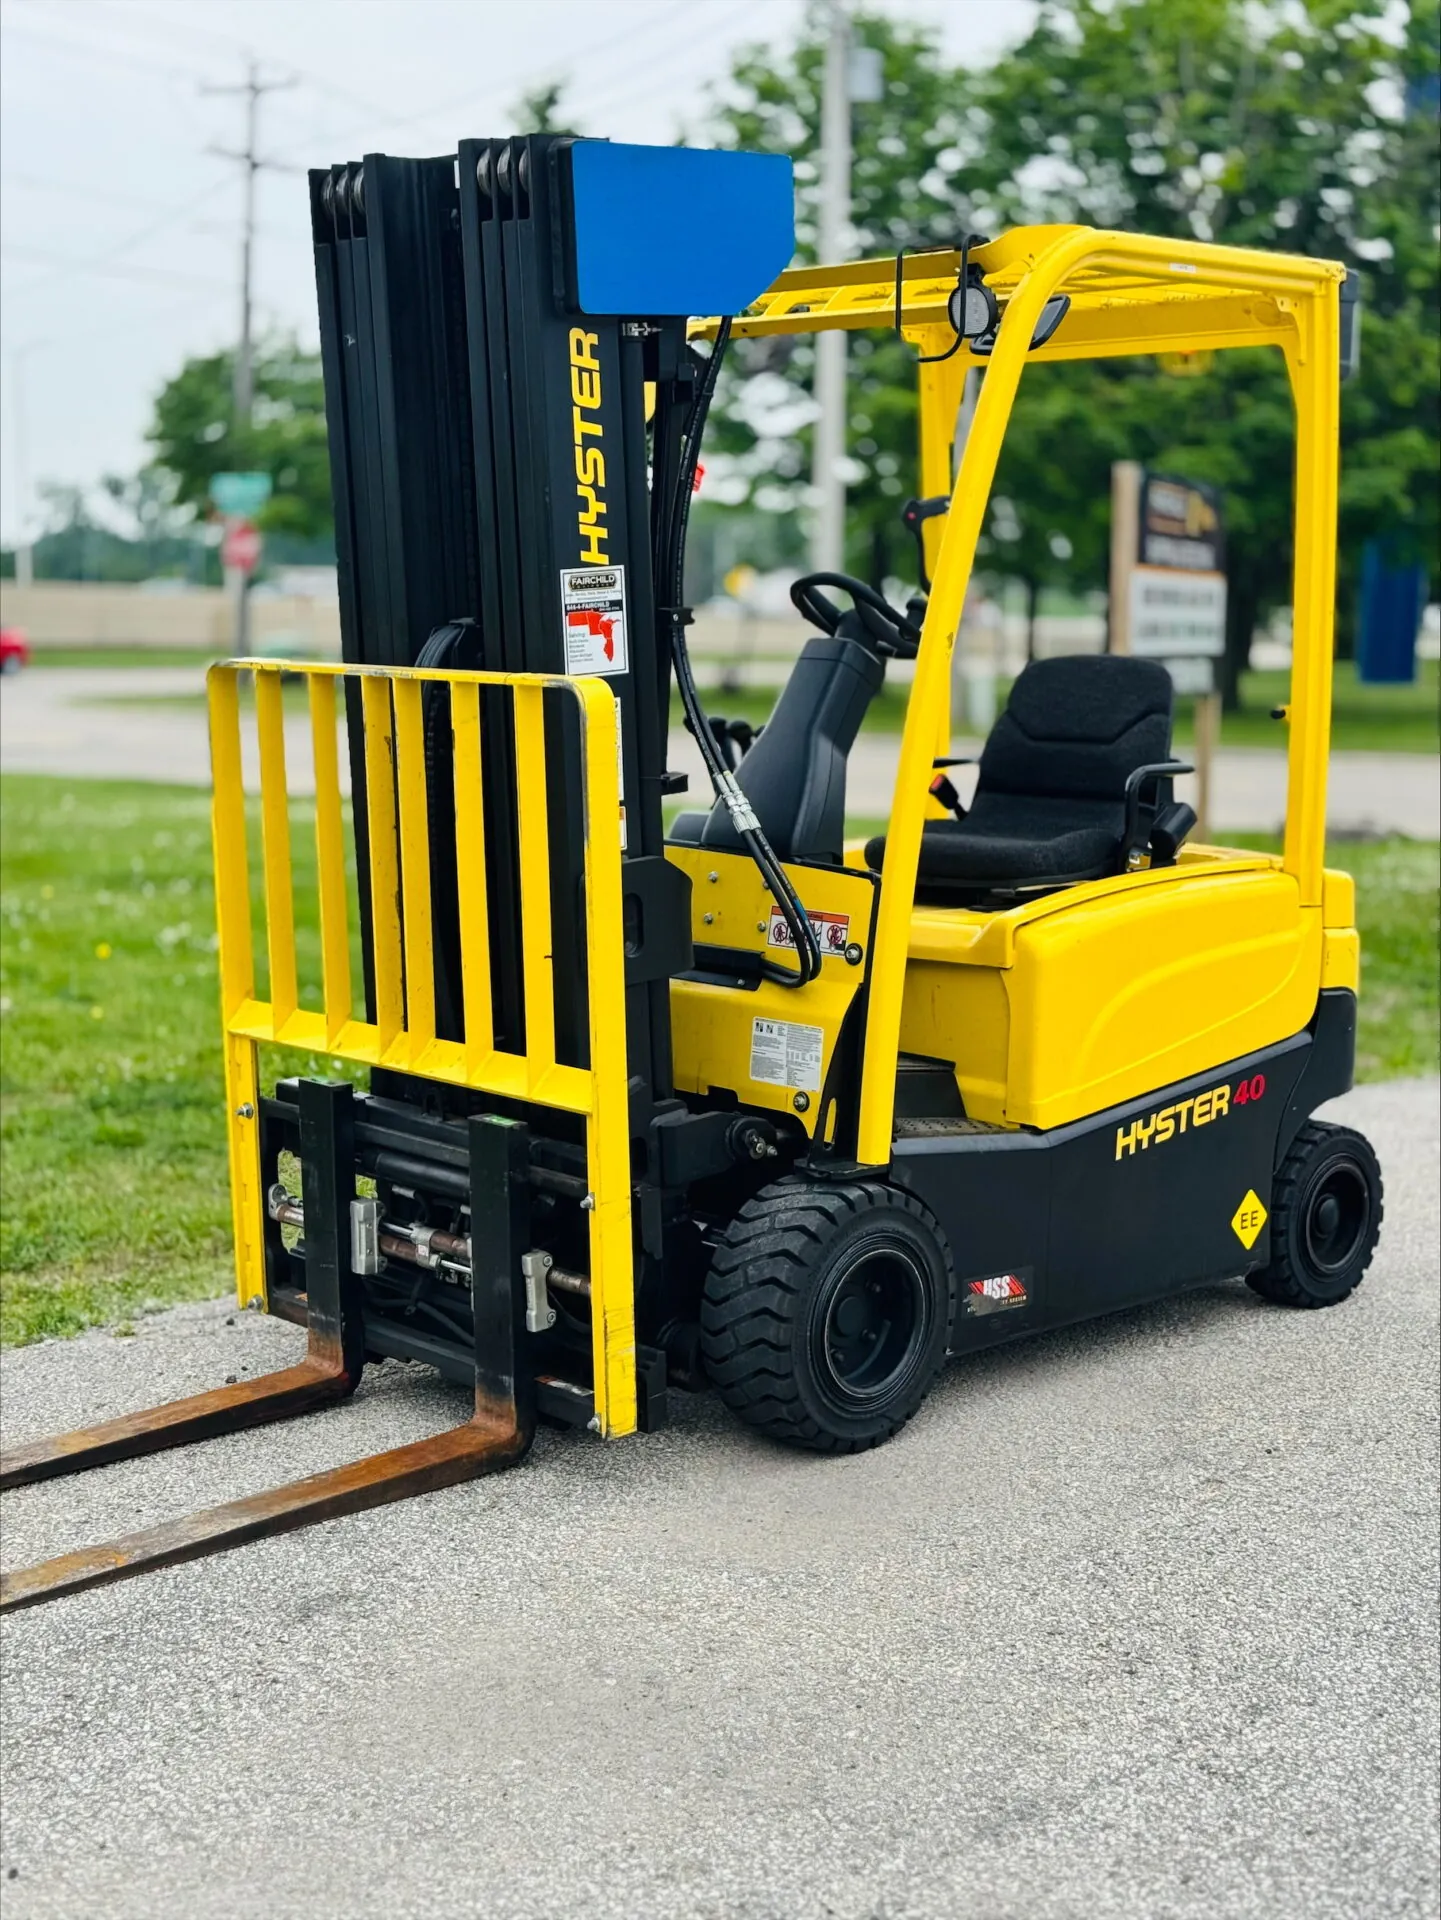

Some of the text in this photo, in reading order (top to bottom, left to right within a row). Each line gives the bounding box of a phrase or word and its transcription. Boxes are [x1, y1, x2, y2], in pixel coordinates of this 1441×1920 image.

[569, 327, 610, 566] HYSTER
[571, 575, 615, 586] FAIRCHILD
[1115, 1074, 1266, 1161] HYSTER 40
[1240, 1210, 1259, 1230] EE
